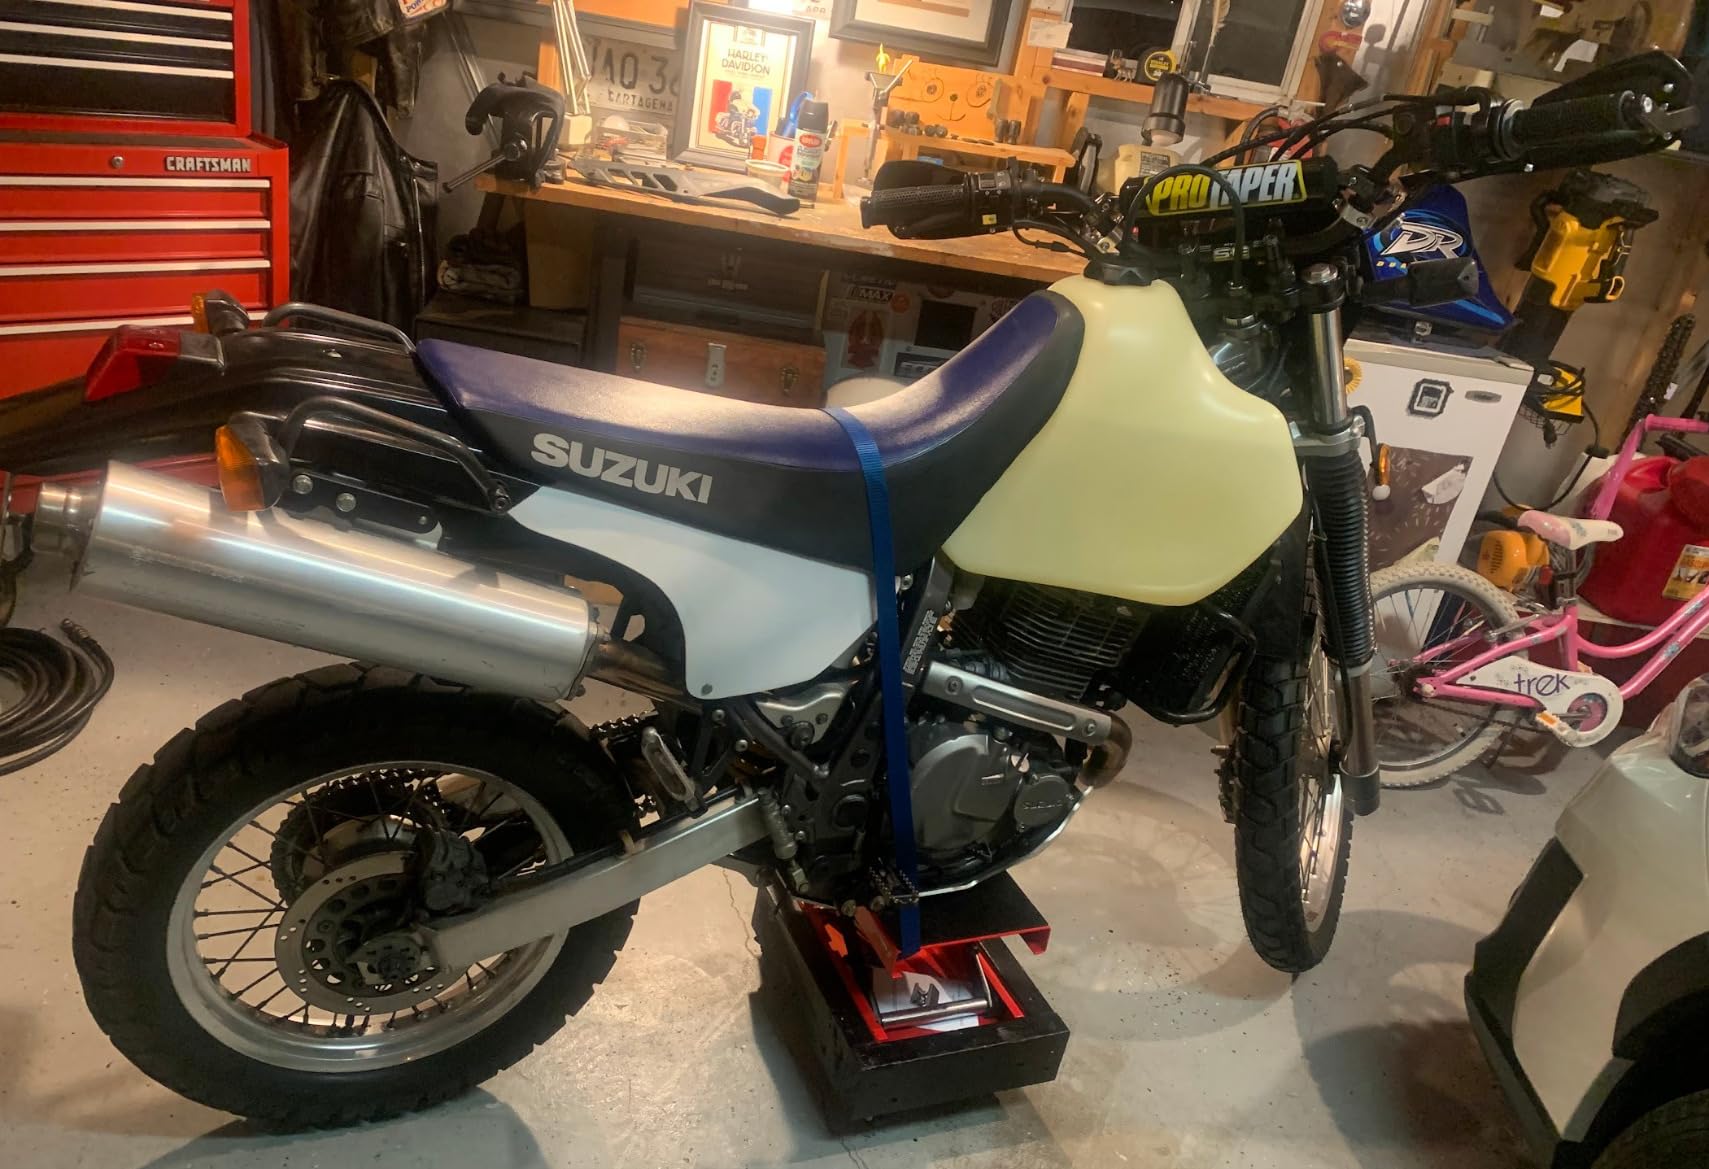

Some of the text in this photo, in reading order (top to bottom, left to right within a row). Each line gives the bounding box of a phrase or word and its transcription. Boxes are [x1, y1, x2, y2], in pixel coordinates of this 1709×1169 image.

[721, 58, 770, 75] DAVIDSON
[165, 155, 252, 172] CRAFTSMAN
[1380, 221, 1463, 259] DR
[531, 432, 713, 504] SUZUKI
[1513, 673, 1570, 696] trek
